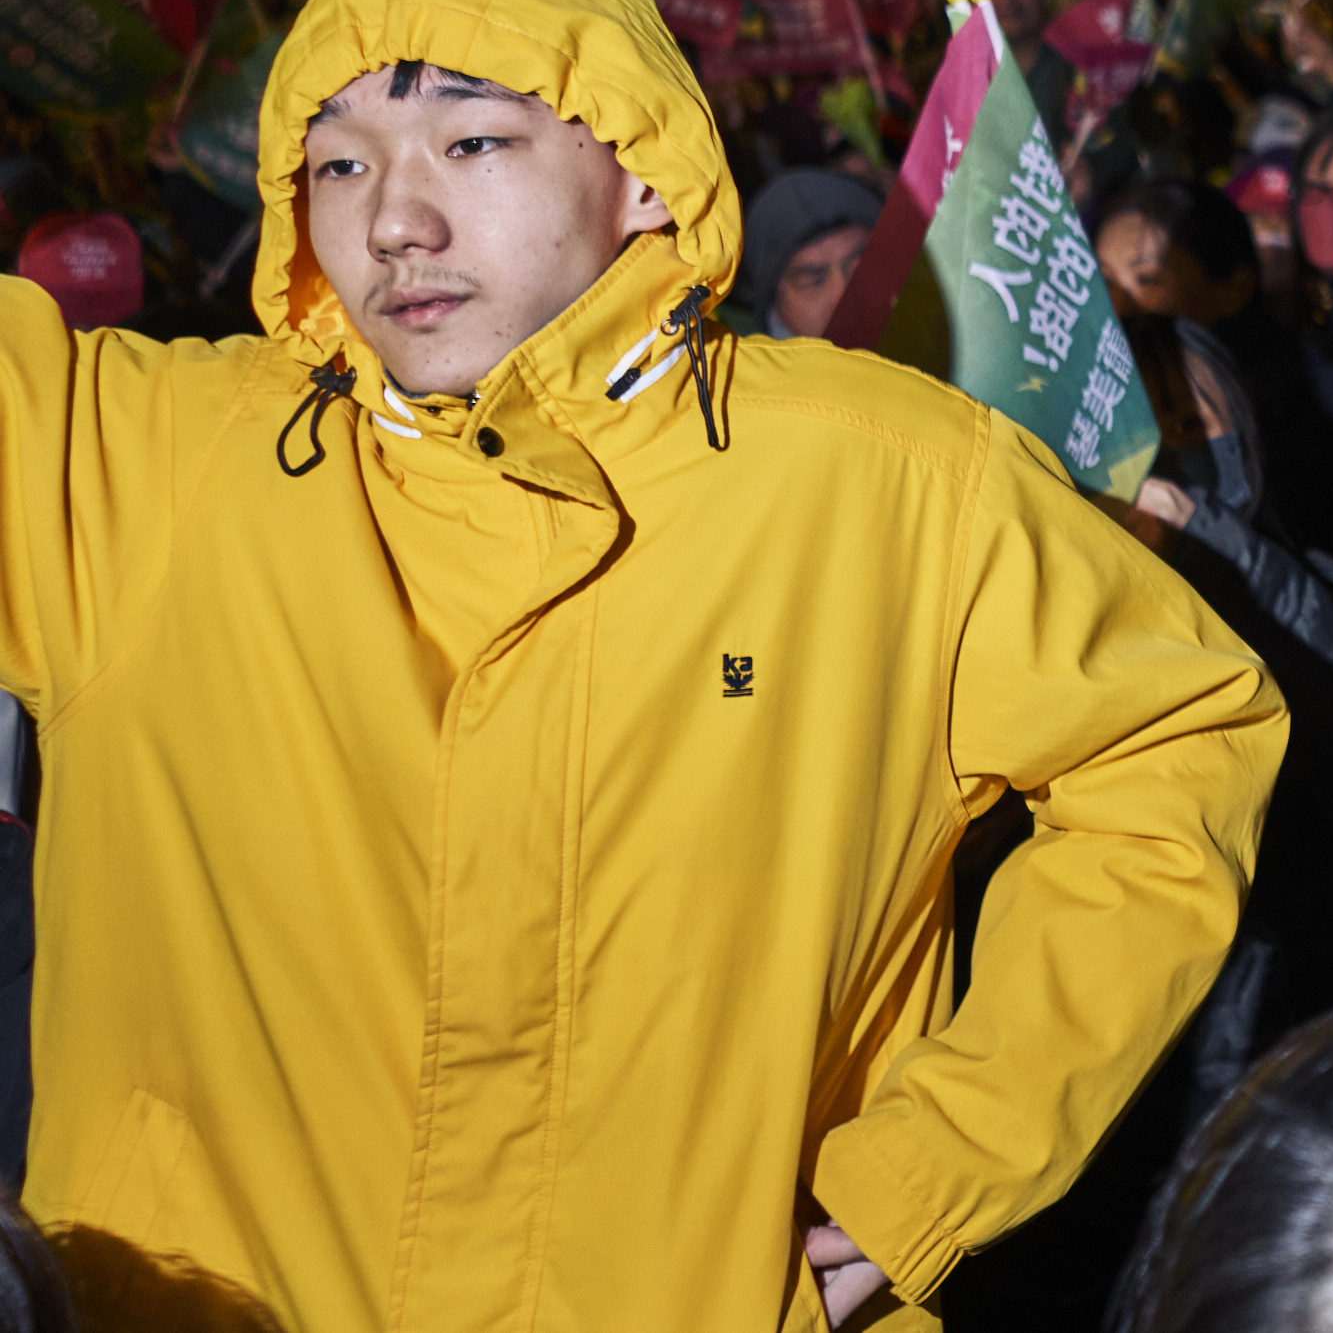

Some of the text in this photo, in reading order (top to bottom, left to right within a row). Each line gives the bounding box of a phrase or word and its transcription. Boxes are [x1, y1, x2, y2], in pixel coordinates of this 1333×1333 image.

[968, 116, 1065, 323] 對的人
[1022, 213, 1098, 372] 的路!
